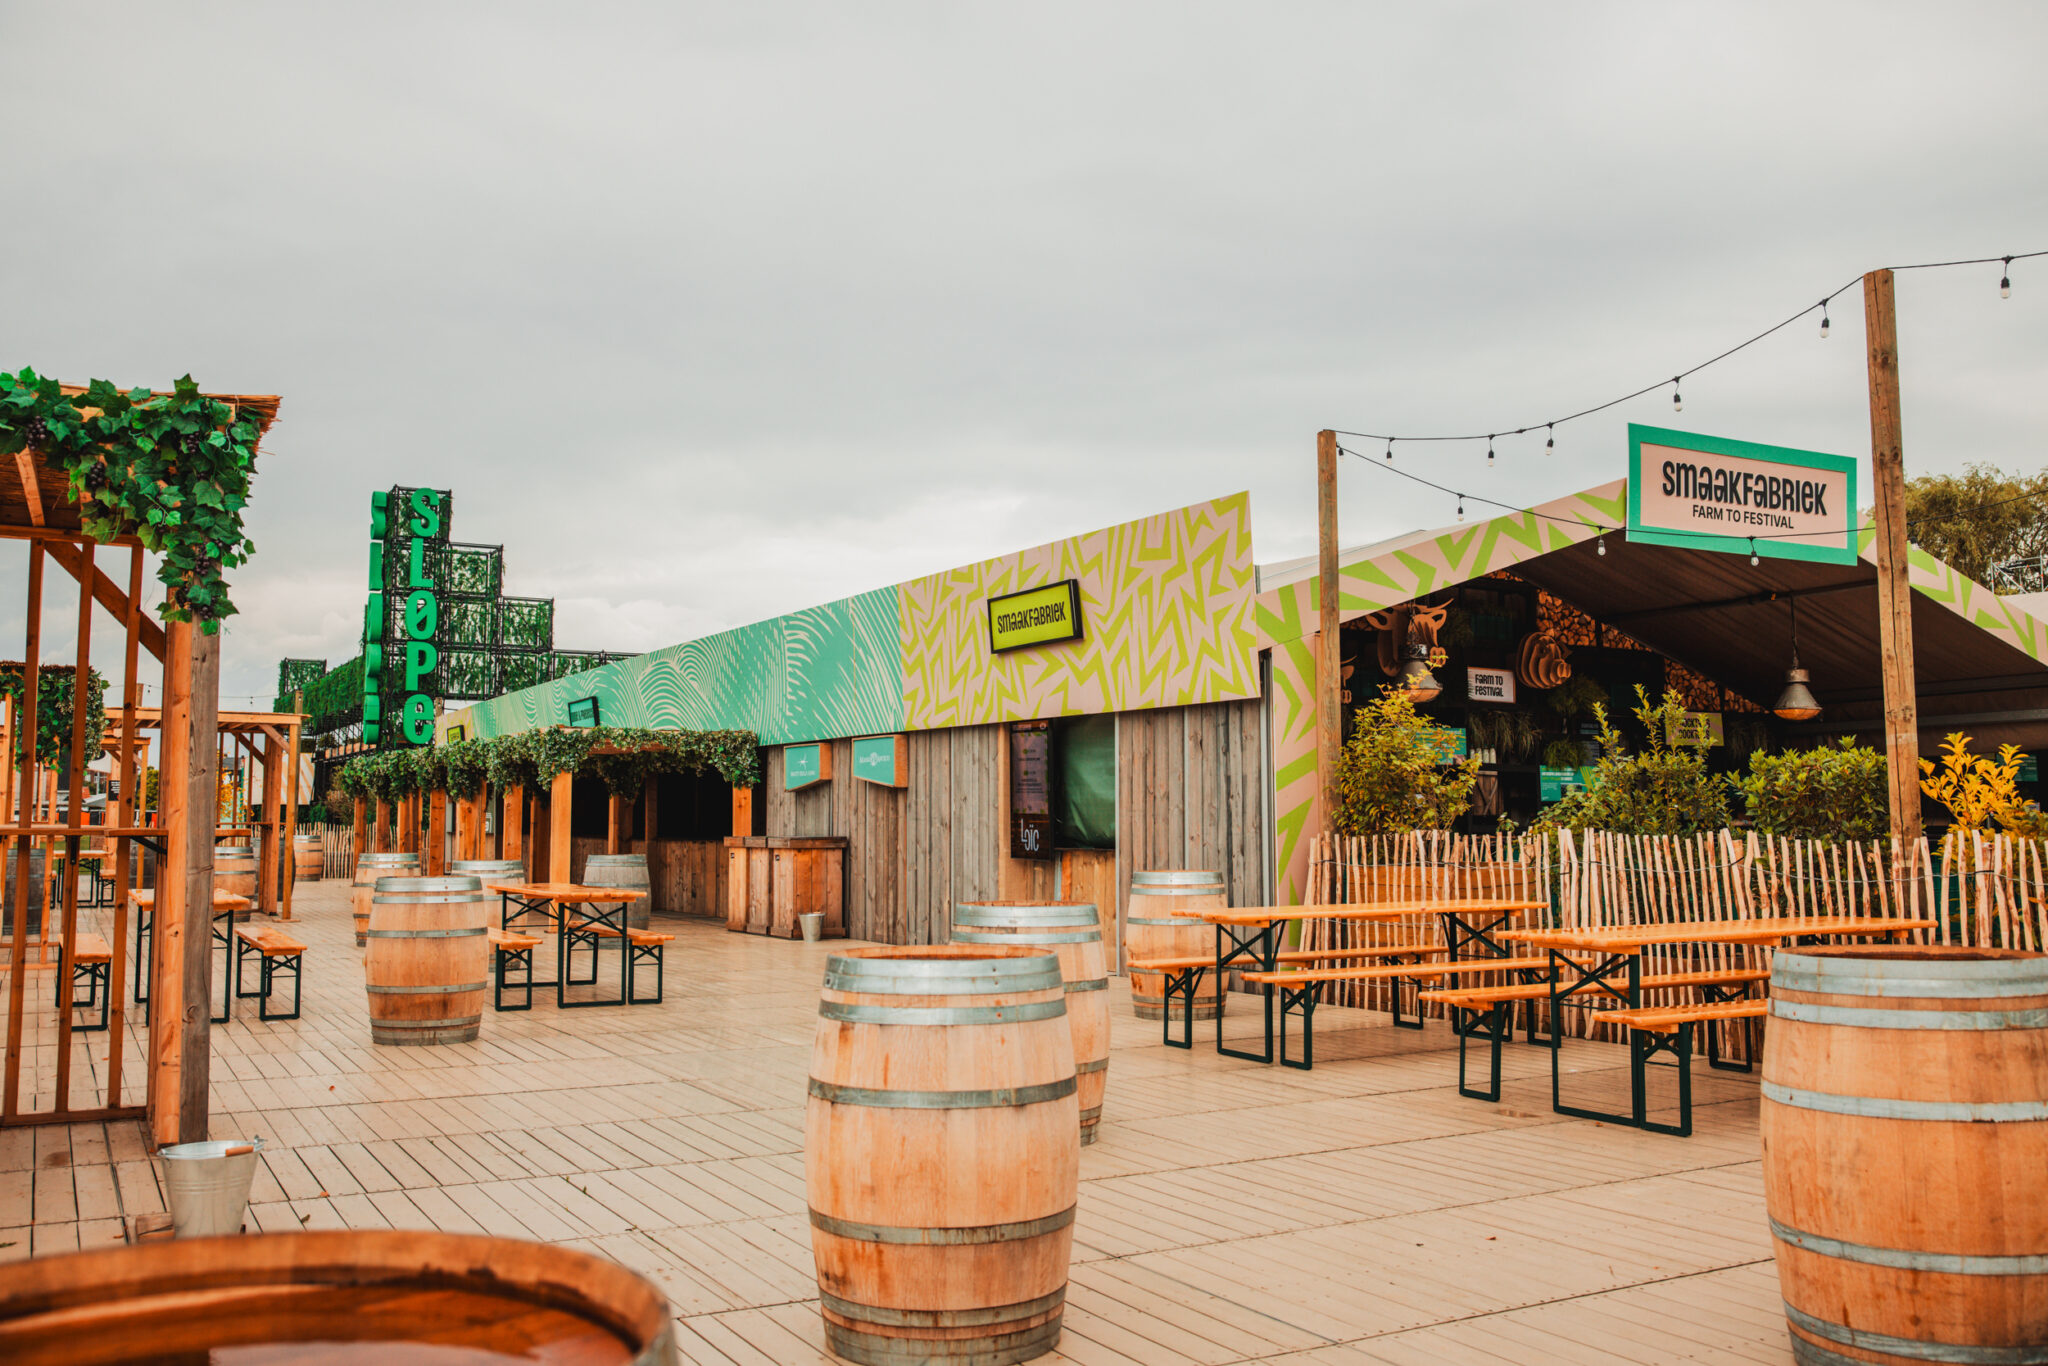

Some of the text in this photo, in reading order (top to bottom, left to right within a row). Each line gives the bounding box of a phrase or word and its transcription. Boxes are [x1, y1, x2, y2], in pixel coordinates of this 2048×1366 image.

[1692, 504, 1795, 529] FARM TO FESTIVAL
[1495, 675, 1504, 686] TO
